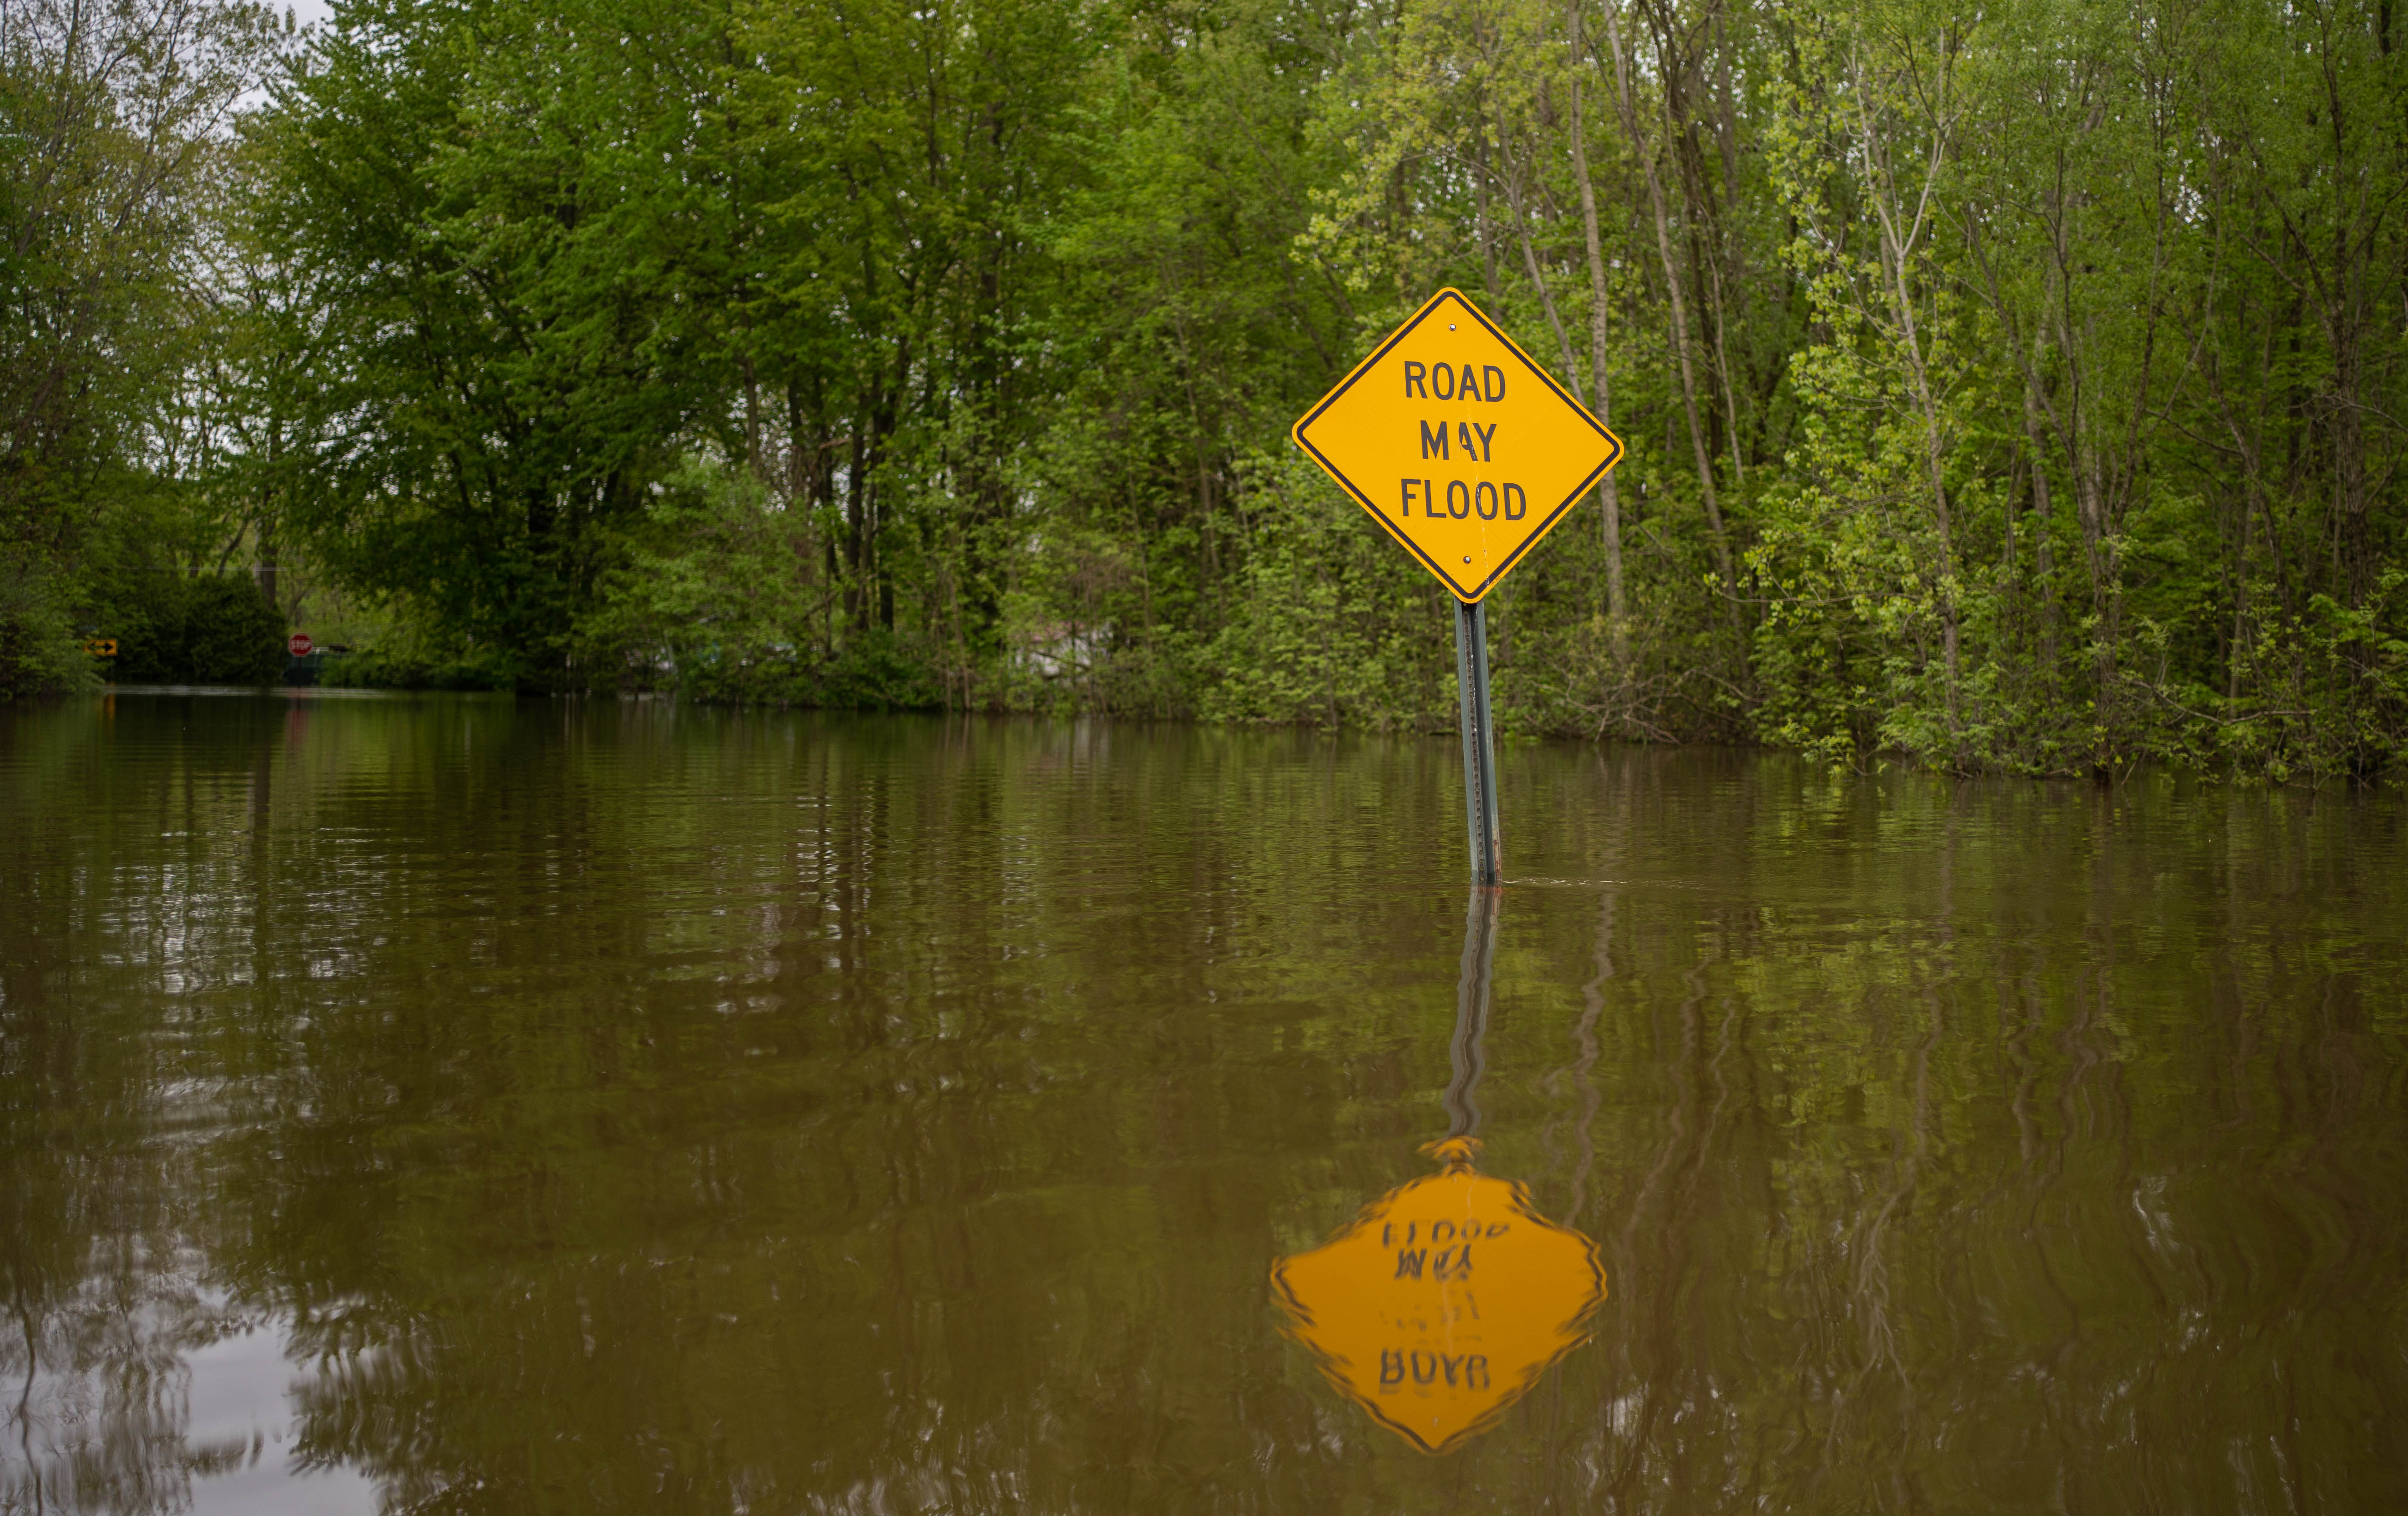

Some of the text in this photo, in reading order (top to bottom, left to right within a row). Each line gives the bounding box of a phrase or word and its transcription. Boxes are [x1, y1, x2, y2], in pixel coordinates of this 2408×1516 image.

[1404, 361, 1506, 402] ROAD
[1421, 420, 1497, 462] MAY
[1401, 478, 1526, 521] FLOOD
[290, 640, 311, 650] STOP
